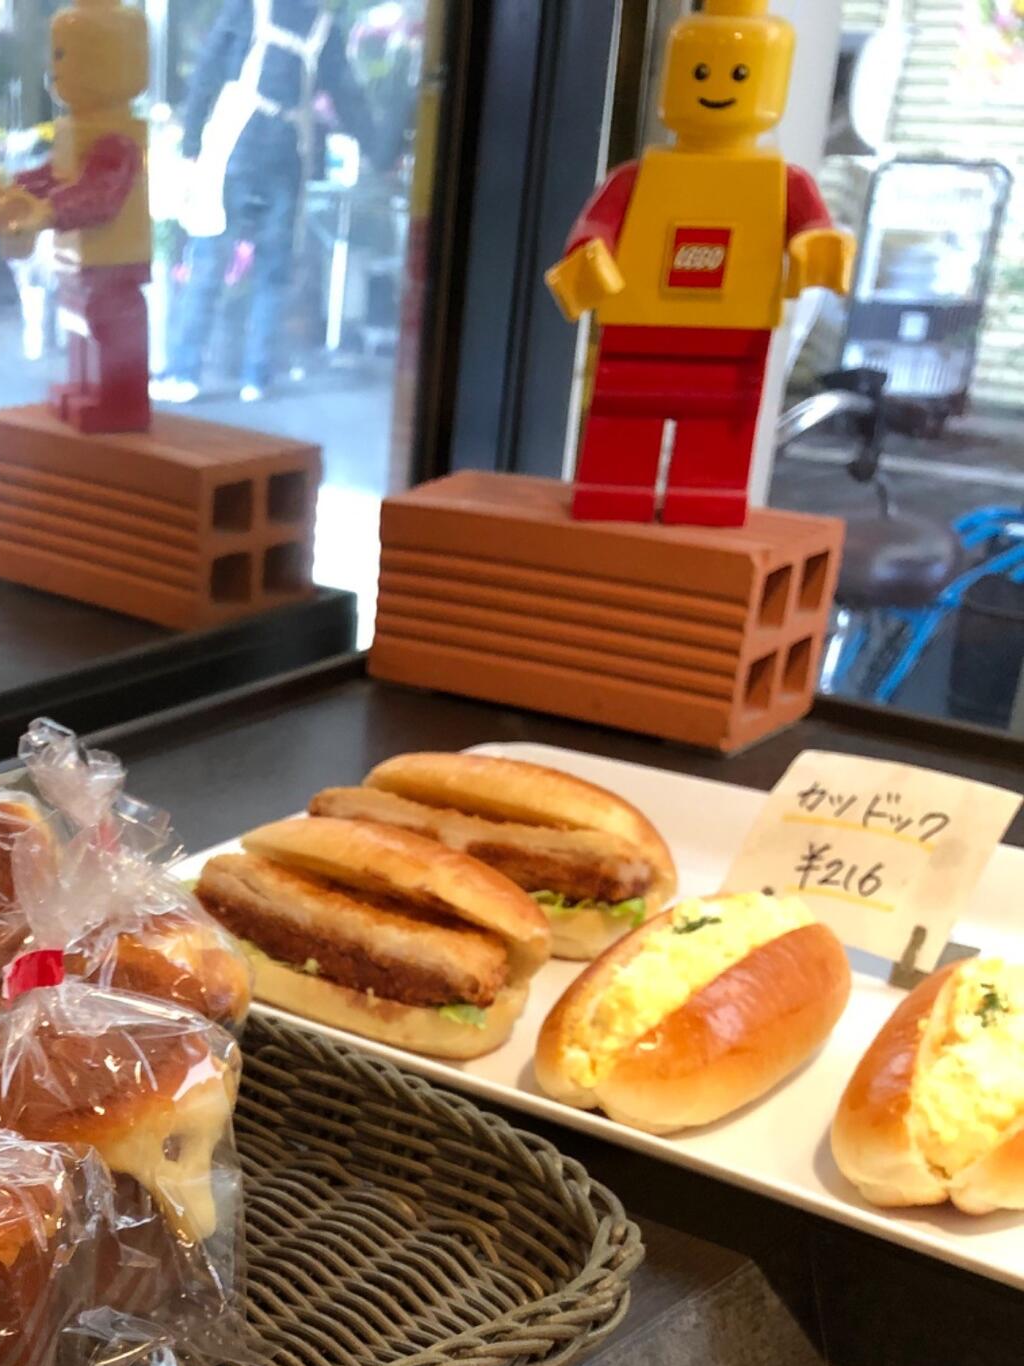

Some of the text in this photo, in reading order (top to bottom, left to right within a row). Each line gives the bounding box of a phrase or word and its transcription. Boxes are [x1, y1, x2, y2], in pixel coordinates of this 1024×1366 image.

[674, 244, 725, 271] LEGO
[796, 780, 951, 843] カツドック
[794, 841, 886, 898] ¥216
